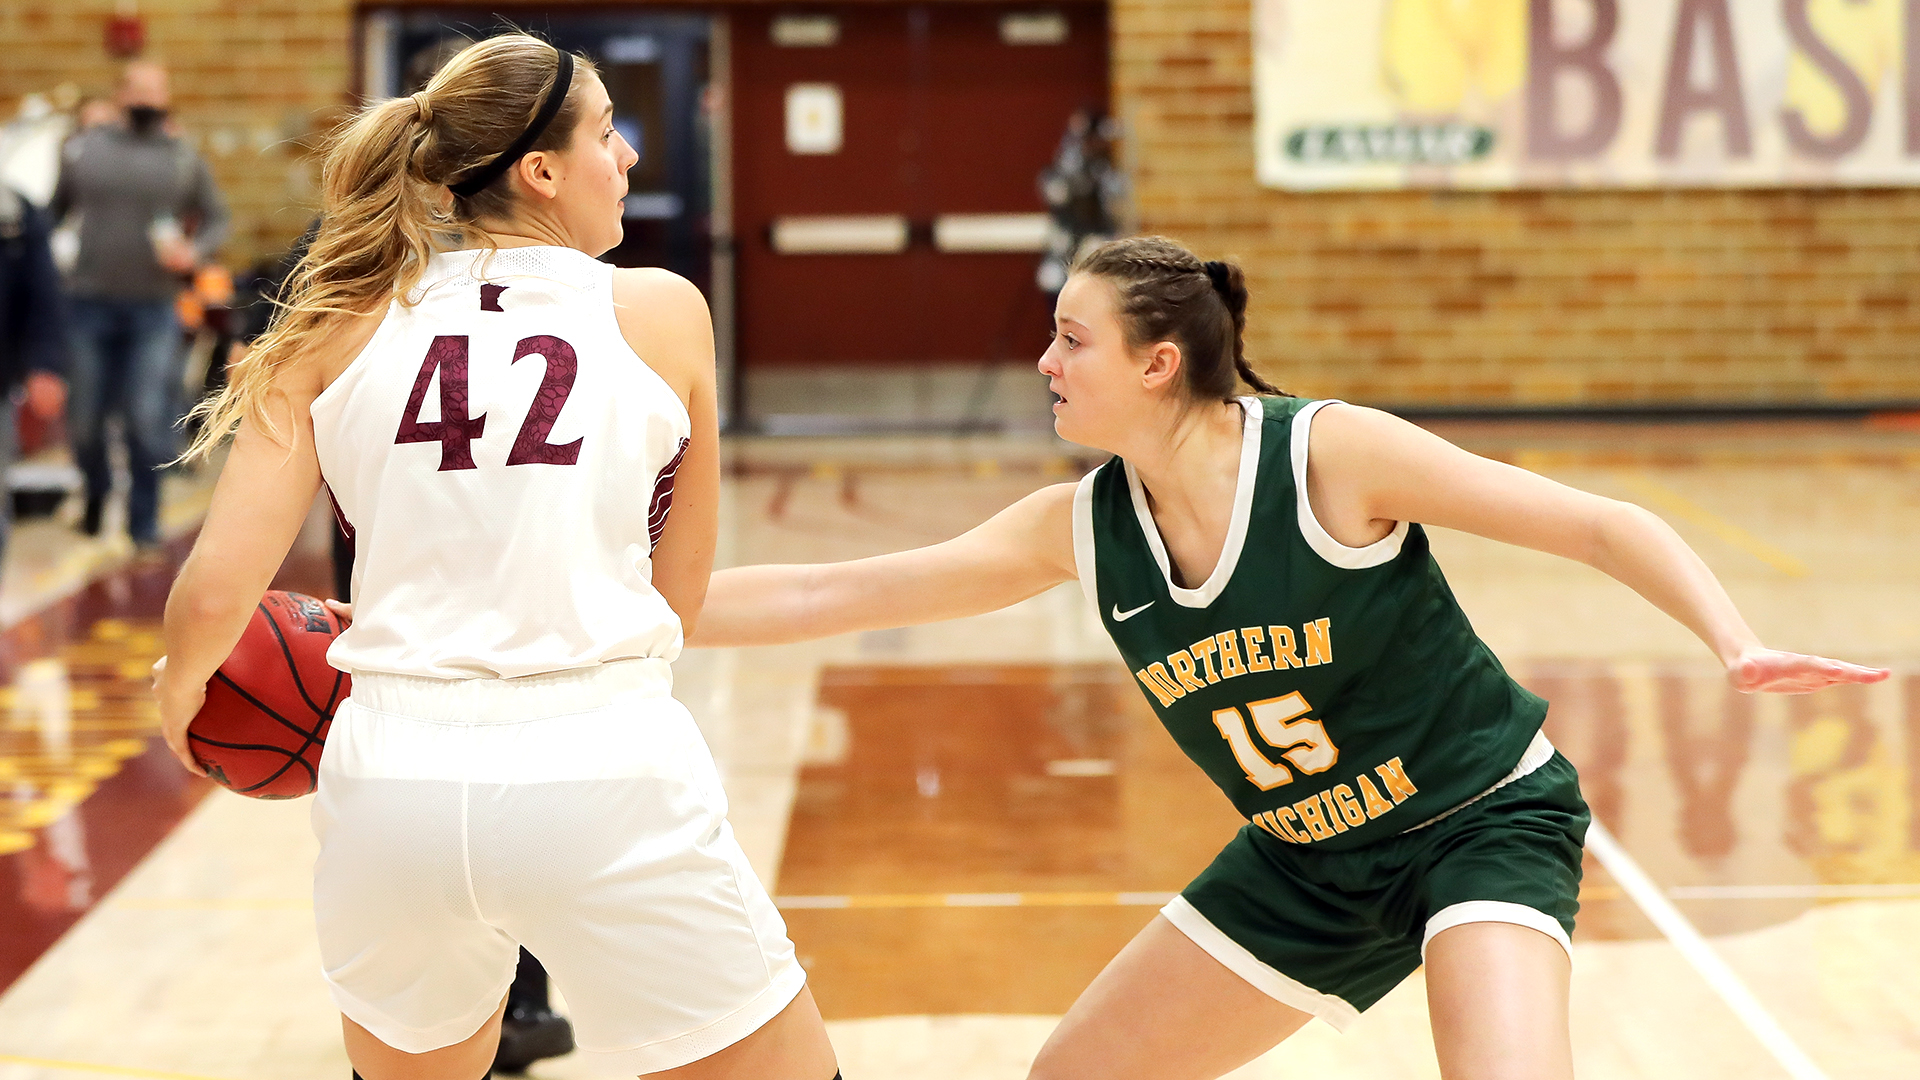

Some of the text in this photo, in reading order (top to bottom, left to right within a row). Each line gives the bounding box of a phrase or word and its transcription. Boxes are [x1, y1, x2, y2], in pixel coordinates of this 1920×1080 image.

[1525, 0, 1920, 160] BAS
[394, 334, 584, 471] 42
[1136, 617, 1333, 708] NORTHERN
[1212, 690, 1340, 792] 15
